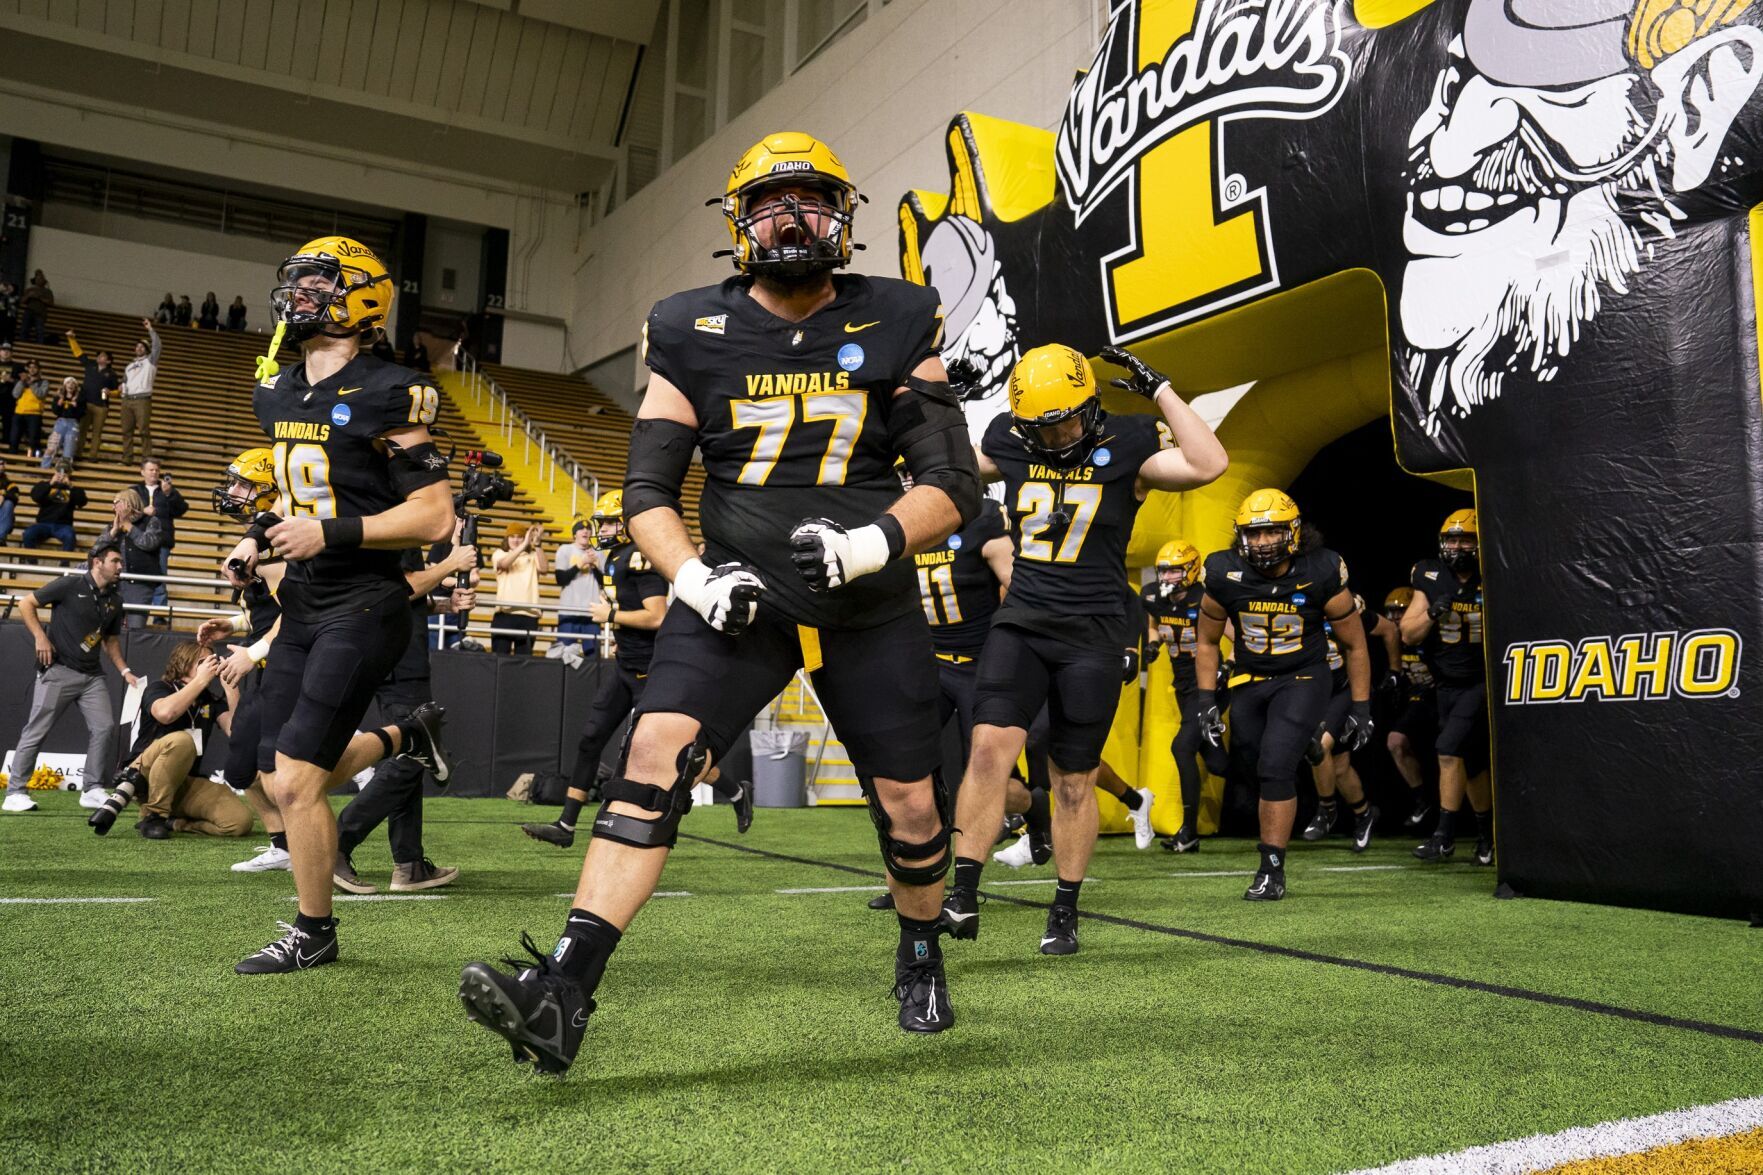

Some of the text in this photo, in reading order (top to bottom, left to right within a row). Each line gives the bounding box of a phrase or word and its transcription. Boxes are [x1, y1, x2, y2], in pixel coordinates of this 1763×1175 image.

[1058, 0, 1337, 198] Vandals
[775, 161, 811, 171] IDAHO
[8, 213, 27, 229] 21
[403, 280, 419, 294] 21
[488, 294, 504, 307] 22
[745, 371, 850, 396] VANDALS
[408, 385, 439, 424] 19
[274, 421, 330, 442] VANDALS
[730, 390, 868, 486] 77
[272, 441, 337, 520] 19
[1029, 464, 1094, 481] VANALS
[1017, 481, 1103, 563] 27
[914, 549, 955, 567] ANDALS
[917, 563, 963, 626] 11
[1249, 601, 1298, 614] VANDALS
[1160, 616, 1191, 627] VANDALS
[1239, 611, 1304, 655] 52
[1506, 631, 1740, 702] IDAHO
